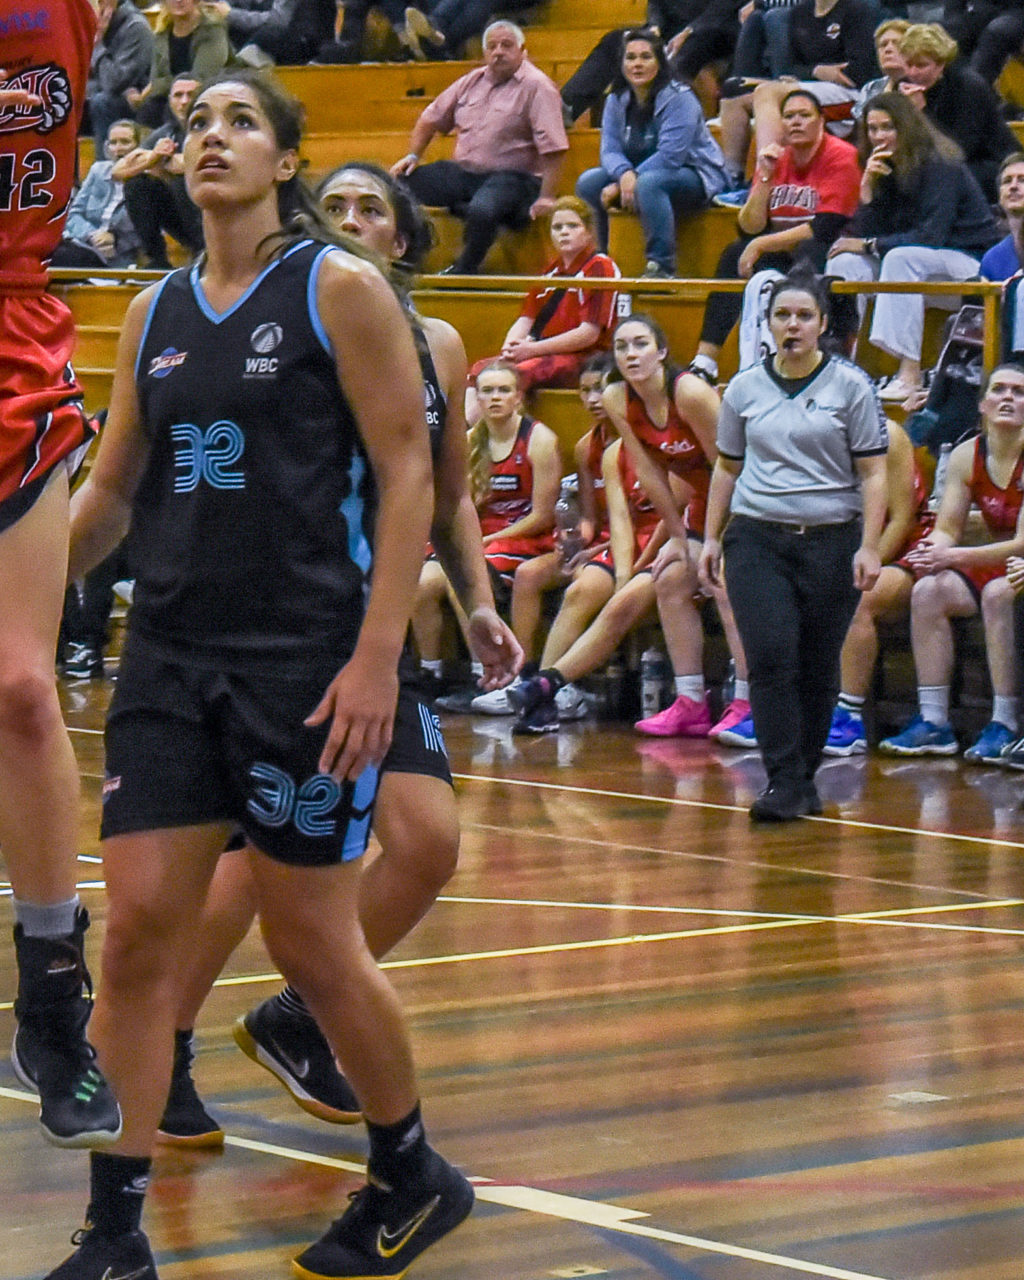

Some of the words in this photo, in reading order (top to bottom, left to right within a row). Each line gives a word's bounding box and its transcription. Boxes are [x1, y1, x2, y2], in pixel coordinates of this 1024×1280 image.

[245, 356, 279, 373] WBC
[425, 411, 439, 425] BC
[170, 420, 246, 493] 32
[247, 761, 341, 837] 32
